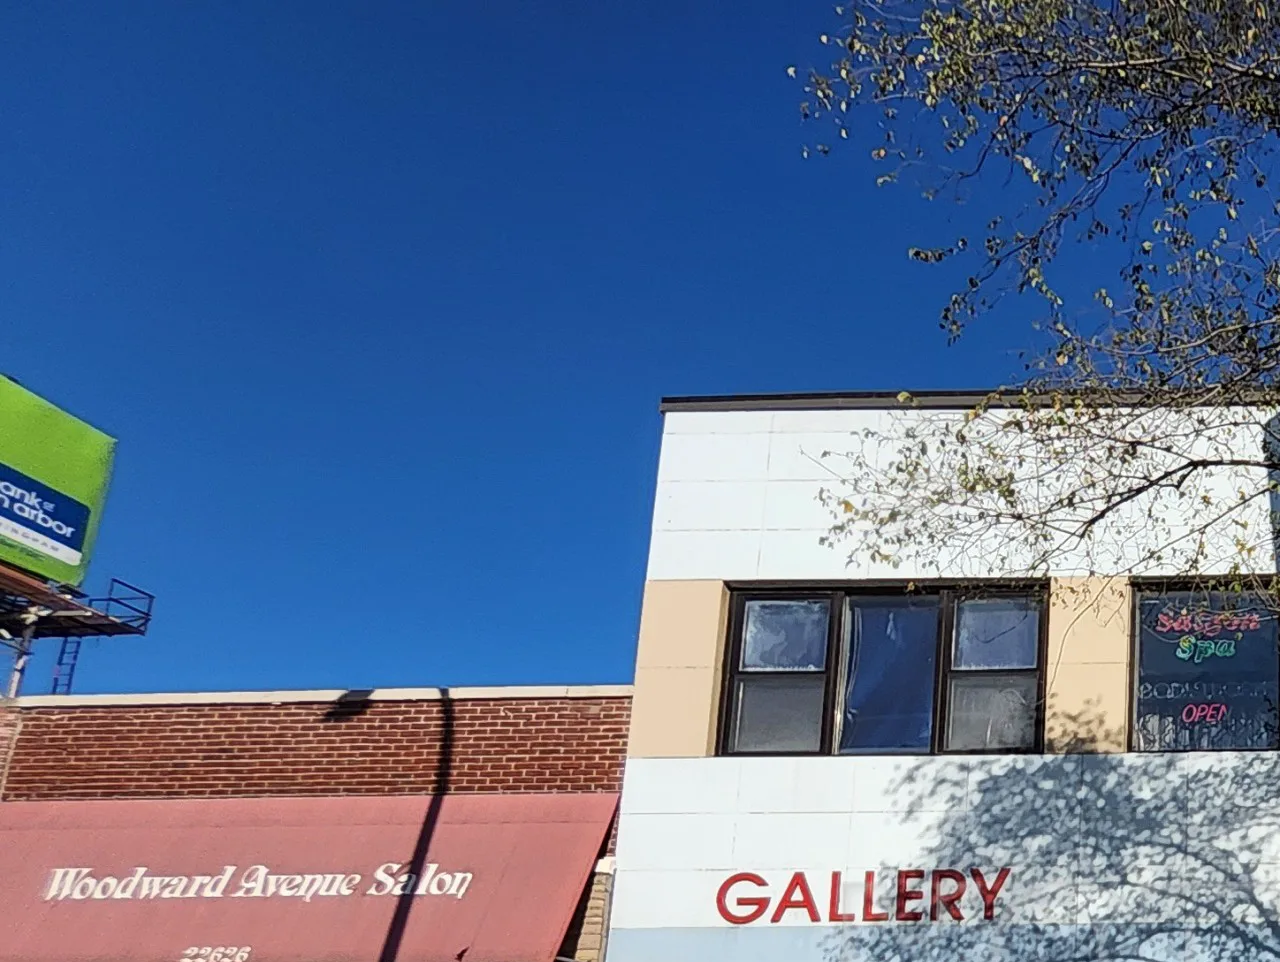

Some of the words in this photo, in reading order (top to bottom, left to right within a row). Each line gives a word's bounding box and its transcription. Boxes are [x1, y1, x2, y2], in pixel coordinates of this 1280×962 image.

[0, 481, 42, 510] ank
[13, 502, 76, 538] arbor
[1175, 634, 1236, 663] Spa
[1181, 703, 1230, 723] OPEN
[43, 866, 238, 901] Woodward
[231, 864, 361, 902] Avenue
[366, 863, 473, 899] Salon
[716, 867, 1011, 925] GALLERY
